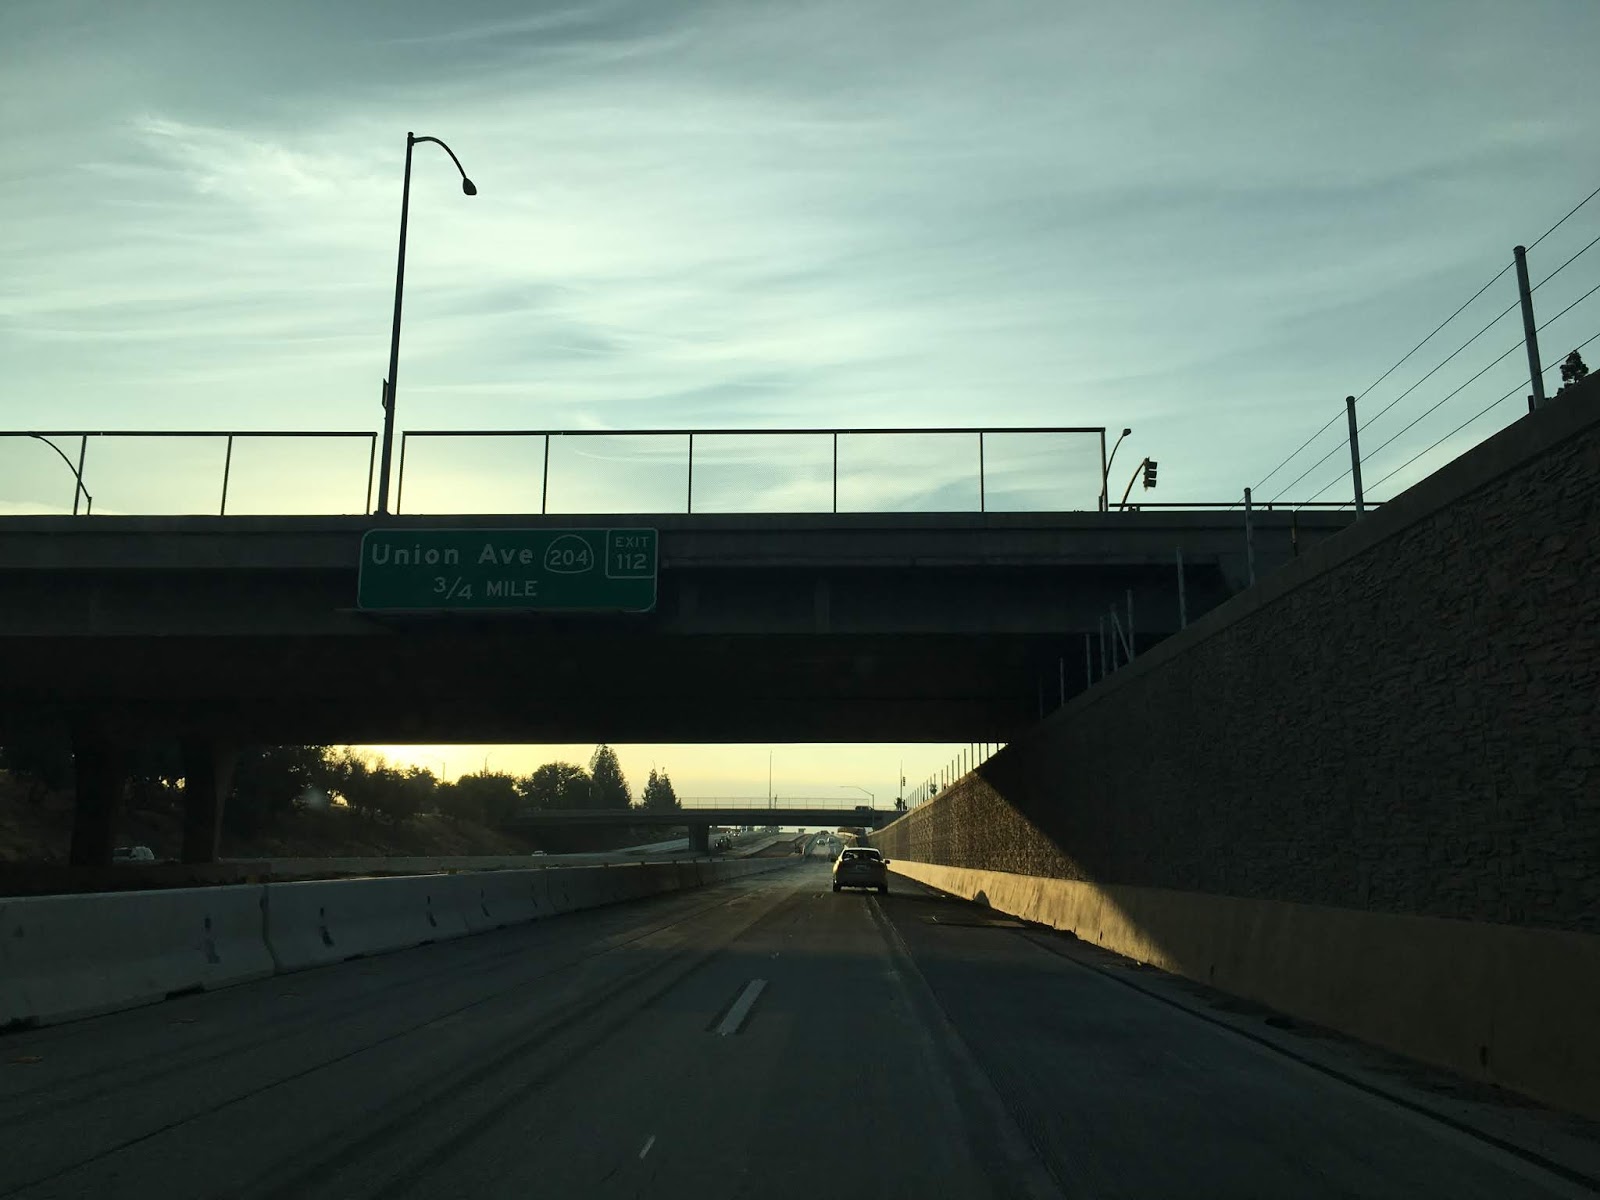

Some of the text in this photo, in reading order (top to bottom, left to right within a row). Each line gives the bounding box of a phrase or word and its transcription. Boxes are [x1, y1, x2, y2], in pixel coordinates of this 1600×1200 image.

[615, 536, 649, 548] EXIT
[371, 543, 533, 565] Union Ave
[549, 549, 588, 566] 204
[616, 553, 647, 570] 112
[433, 576, 538, 600] 3/4 MILE
